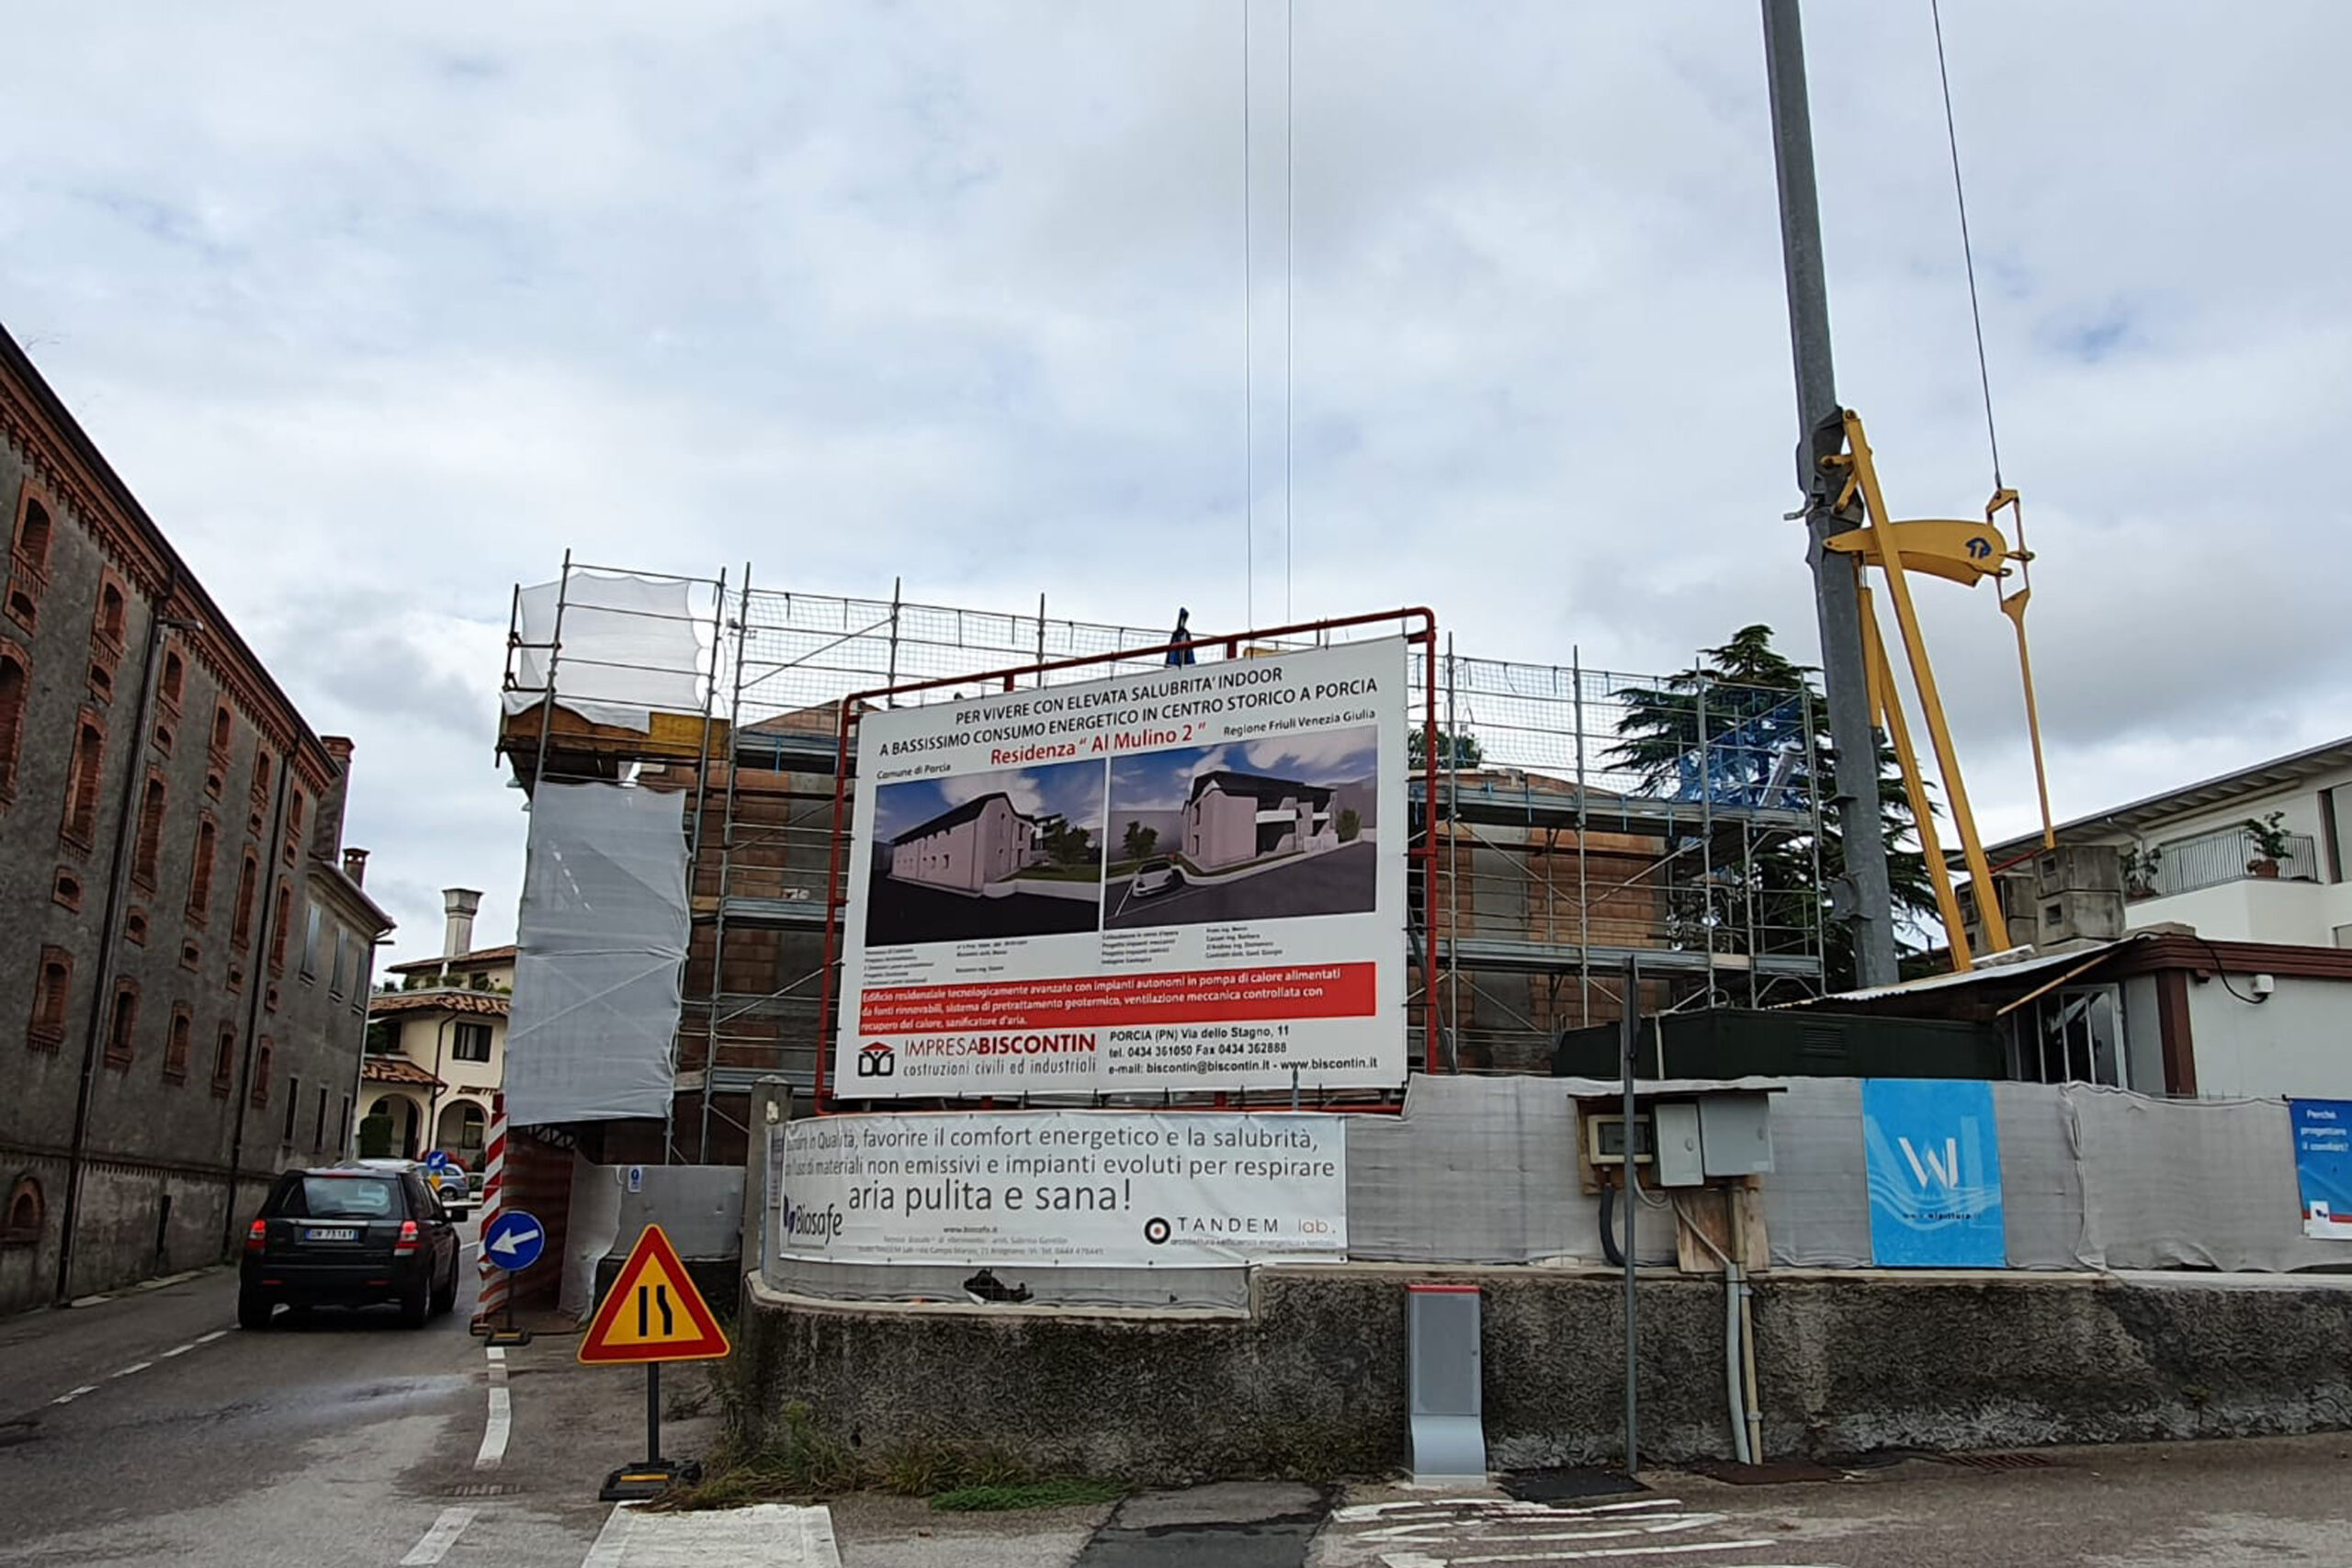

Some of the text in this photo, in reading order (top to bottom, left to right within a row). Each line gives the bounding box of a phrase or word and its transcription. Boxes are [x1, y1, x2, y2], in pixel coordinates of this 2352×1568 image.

[956, 710, 980, 725] PER
[985, 703, 1030, 720] VIVERE
[1034, 698, 1064, 715] CON
[1068, 689, 1127, 710] ELEVATA
[1219, 667, 1283, 689] INDOOR
[879, 678, 1377, 758] A BASSISSIMO CONSUMO ENERGETICO IN CENTRO STORICO A PORCIA
[1224, 708, 1375, 738] Regione Friuli Venezia Giulia
[991, 742, 1076, 765] Residenza
[1114, 728, 1177, 750] Mulino
[876, 763, 951, 780] Comune di Porcia
[862, 968, 1340, 1003] Edificio residenziale tecnologicamente avanzato con impianti autonomi in pompa di calore alimentati
[862, 1006, 873, 1017] da
[875, 1004, 893, 1016] fonti
[946, 1001, 979, 1012] sistema
[981, 999, 990, 1010] di
[992, 998, 1063, 1013] pretrattamento
[1065, 995, 1123, 1010] geotermico,
[1125, 993, 1184, 1006] ventilazione
[1187, 991, 1240, 1002] meccanica
[1243, 987, 1300, 1000] controllata
[1304, 987, 1323, 997] con
[861, 1021, 898, 1033] recupero
[900, 1019, 913, 1030] del
[946, 1016, 997, 1028] sanificatore
[1110, 1025, 1289, 1042] PORCIA (PN) Via dello Stagno, 11
[1109, 1043, 1286, 1058] tel. 0434 361050 Fax 0434 362888
[904, 1056, 1096, 1077] costruzioni civili ed industriali
[1109, 1063, 1144, 1075] e-mail:
[1147, 1060, 1271, 1075] biscontin@biscontin.it
[1281, 1057, 1378, 1071] www.biscontin.it
[864, 1128, 928, 1148] favorire
[934, 1126, 944, 1147] il
[950, 1126, 1032, 1147] comfort
[1039, 1127, 1159, 1149] energetico
[1166, 1132, 1179, 1146] e
[1188, 1126, 1205, 1146] la
[1213, 1128, 1318, 1152] salubrità,
[817, 1155, 863, 1175] materiali
[867, 1159, 899, 1175] non
[904, 1155, 980, 1174] emissivi
[988, 1159, 999, 1174] e
[1006, 1155, 1096, 1178] impianti
[1103, 1154, 1182, 1174] evoluti
[1189, 1159, 1227, 1179] per
[1235, 1156, 1335, 1180] respirare
[849, 1178, 1131, 1217] aria pulita e sana!
[796, 1203, 842, 1245] Biosafe
[1177, 1217, 1278, 1233] TANDEM
